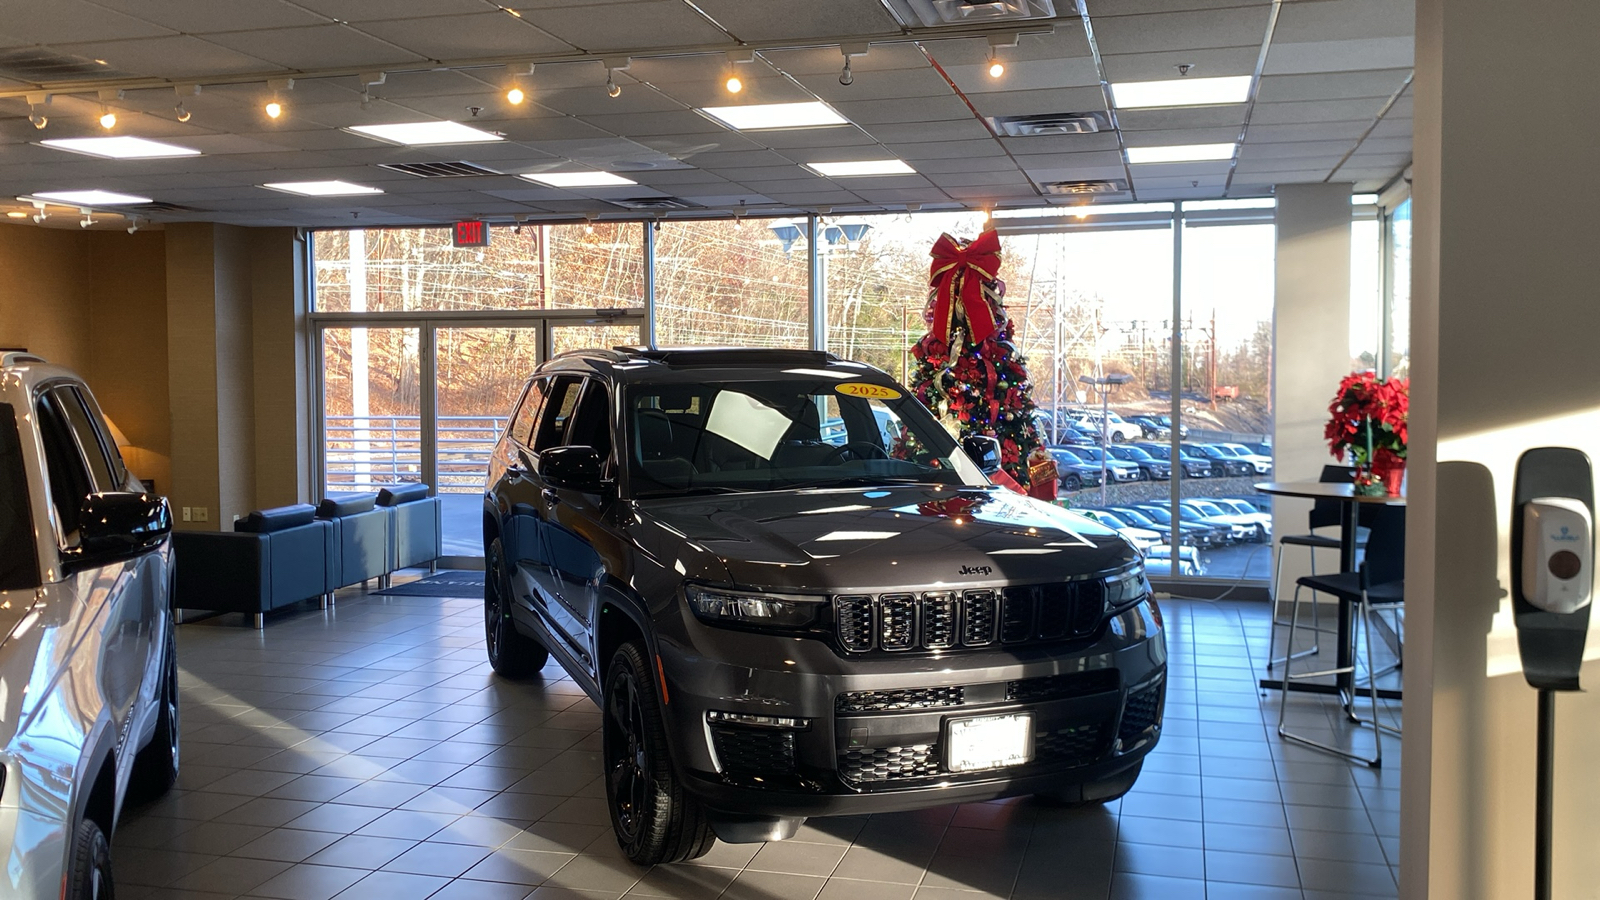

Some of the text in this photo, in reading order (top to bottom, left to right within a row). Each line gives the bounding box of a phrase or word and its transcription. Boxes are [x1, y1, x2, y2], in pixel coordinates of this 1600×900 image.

[457, 221, 482, 244] EXIT
[849, 385, 889, 397] 2025
[958, 564, 993, 576] Jeep
